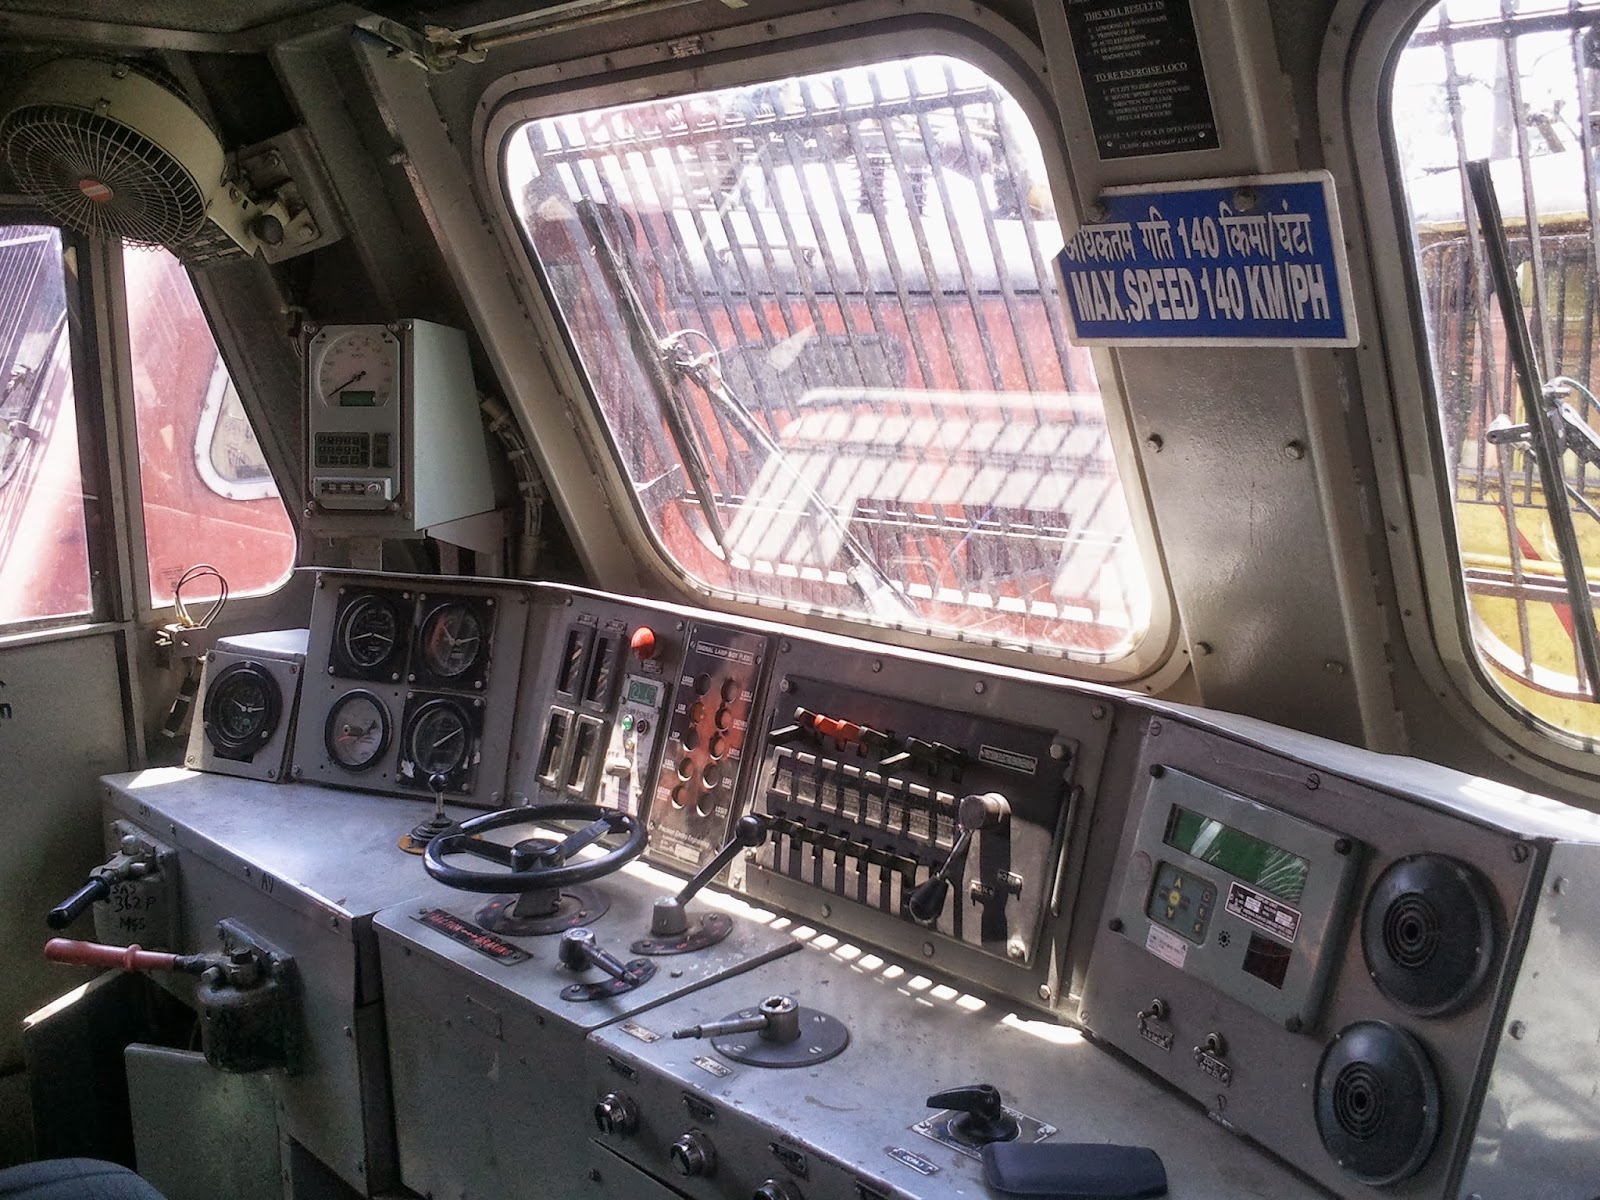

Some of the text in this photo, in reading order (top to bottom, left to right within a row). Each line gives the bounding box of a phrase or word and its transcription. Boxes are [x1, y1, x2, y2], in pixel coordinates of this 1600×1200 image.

[1124, 3, 1153, 15] RESULT
[1094, 73, 1106, 82] TO
[1120, 66, 1160, 79] ENERGISE
[1162, 62, 1188, 74] LOCO
[1136, 205, 1176, 262] गति
[1177, 216, 1220, 259] 140
[1201, 266, 1244, 321] 140
[714, 647, 728, 658] LAMP
[728, 650, 739, 659] BOX
